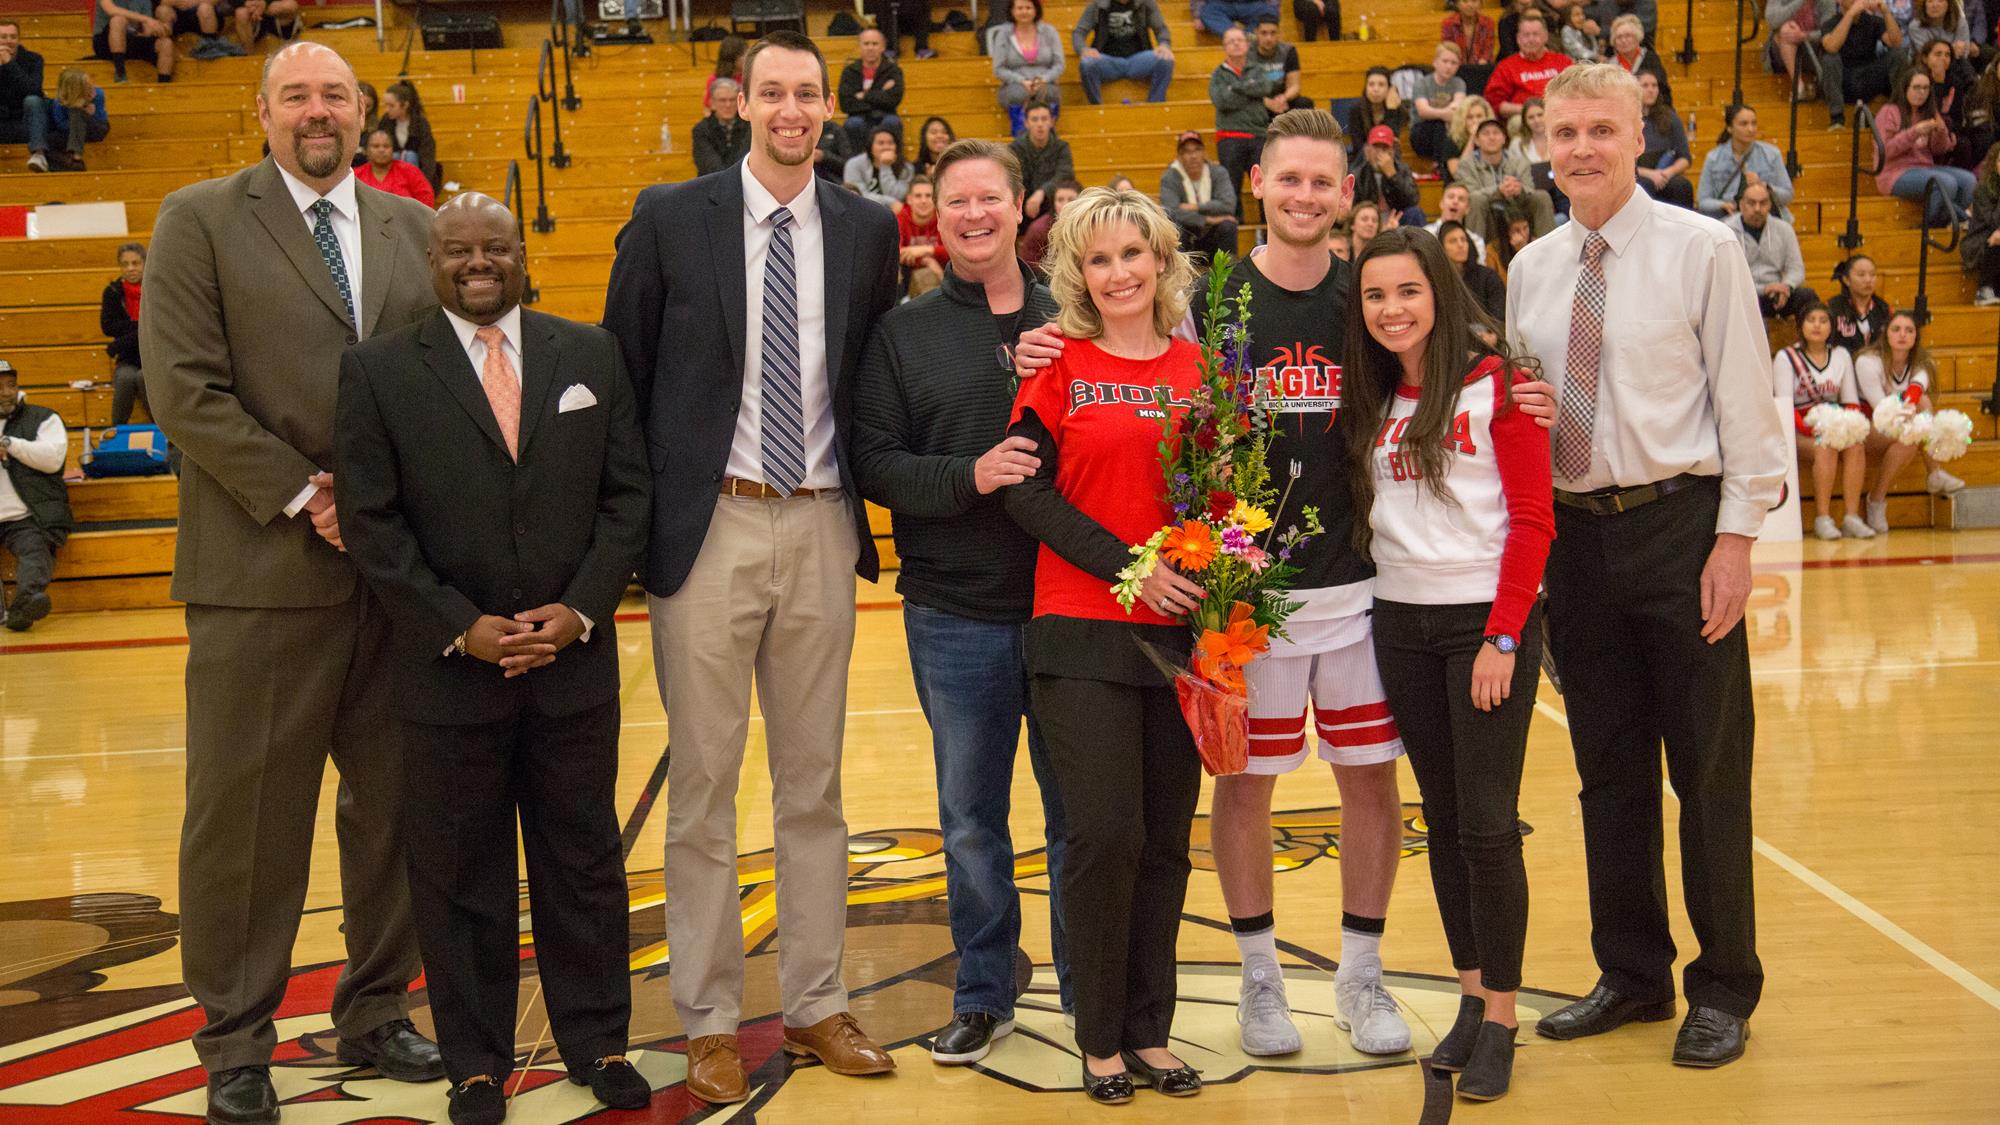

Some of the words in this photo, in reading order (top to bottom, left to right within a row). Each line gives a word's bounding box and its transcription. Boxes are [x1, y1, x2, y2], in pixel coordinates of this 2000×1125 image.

[1068, 379, 1192, 416] BIOL
[1238, 366, 1342, 407] AGLE
[1139, 408, 1166, 418] MOM
[1375, 409, 1477, 456] IOA
